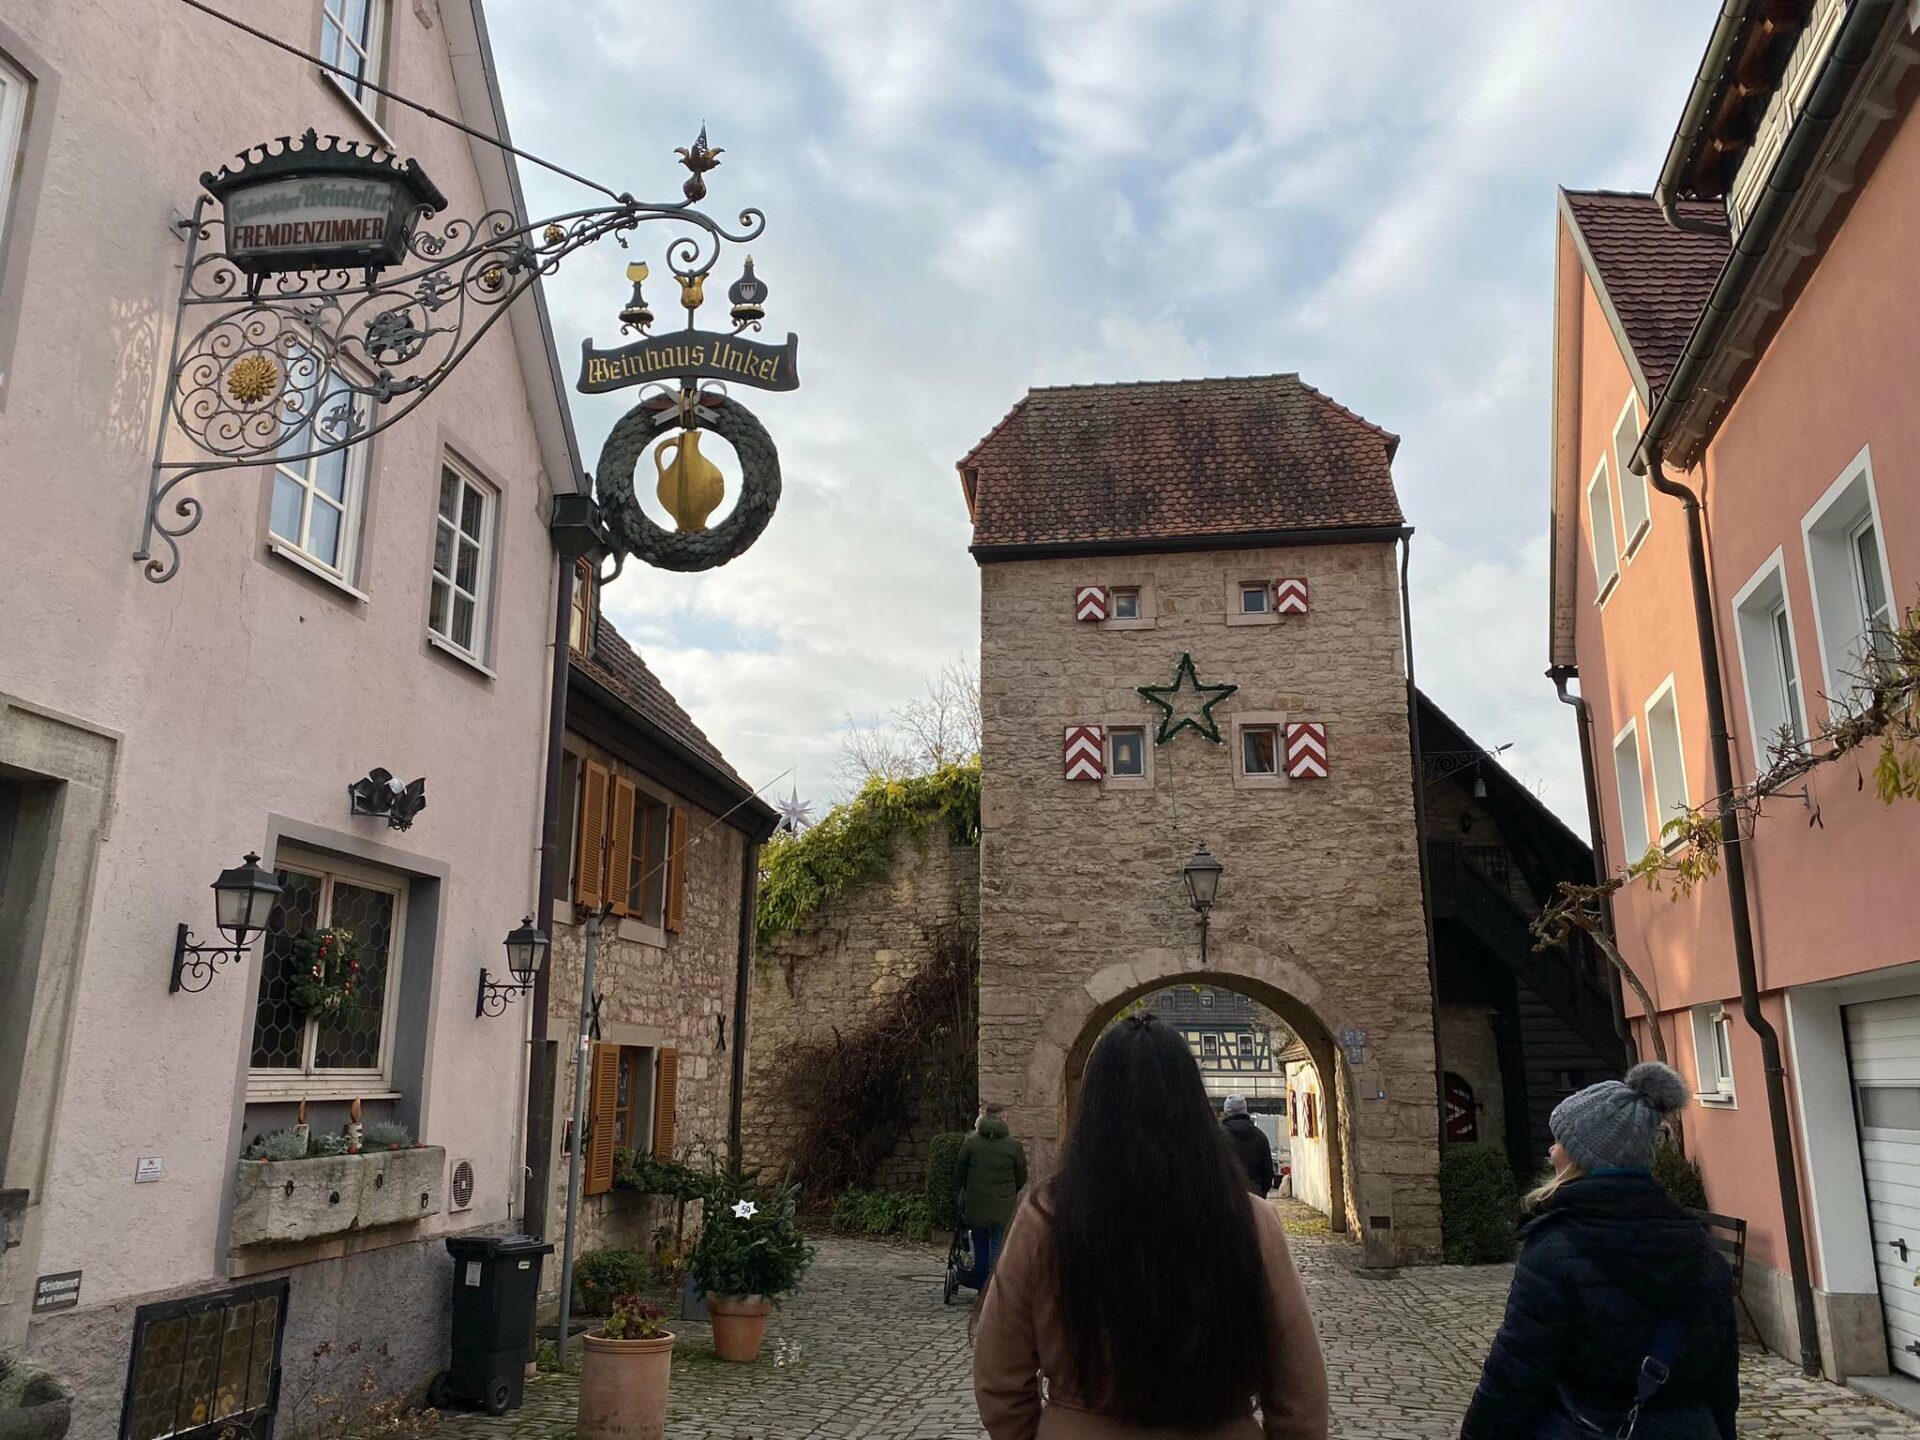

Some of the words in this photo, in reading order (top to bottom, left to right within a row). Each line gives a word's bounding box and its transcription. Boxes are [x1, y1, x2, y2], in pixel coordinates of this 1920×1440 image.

[231, 217, 385, 250] FREMDENZIMMER
[587, 344, 705, 384] Weinhaus
[709, 340, 780, 382] Unkel
